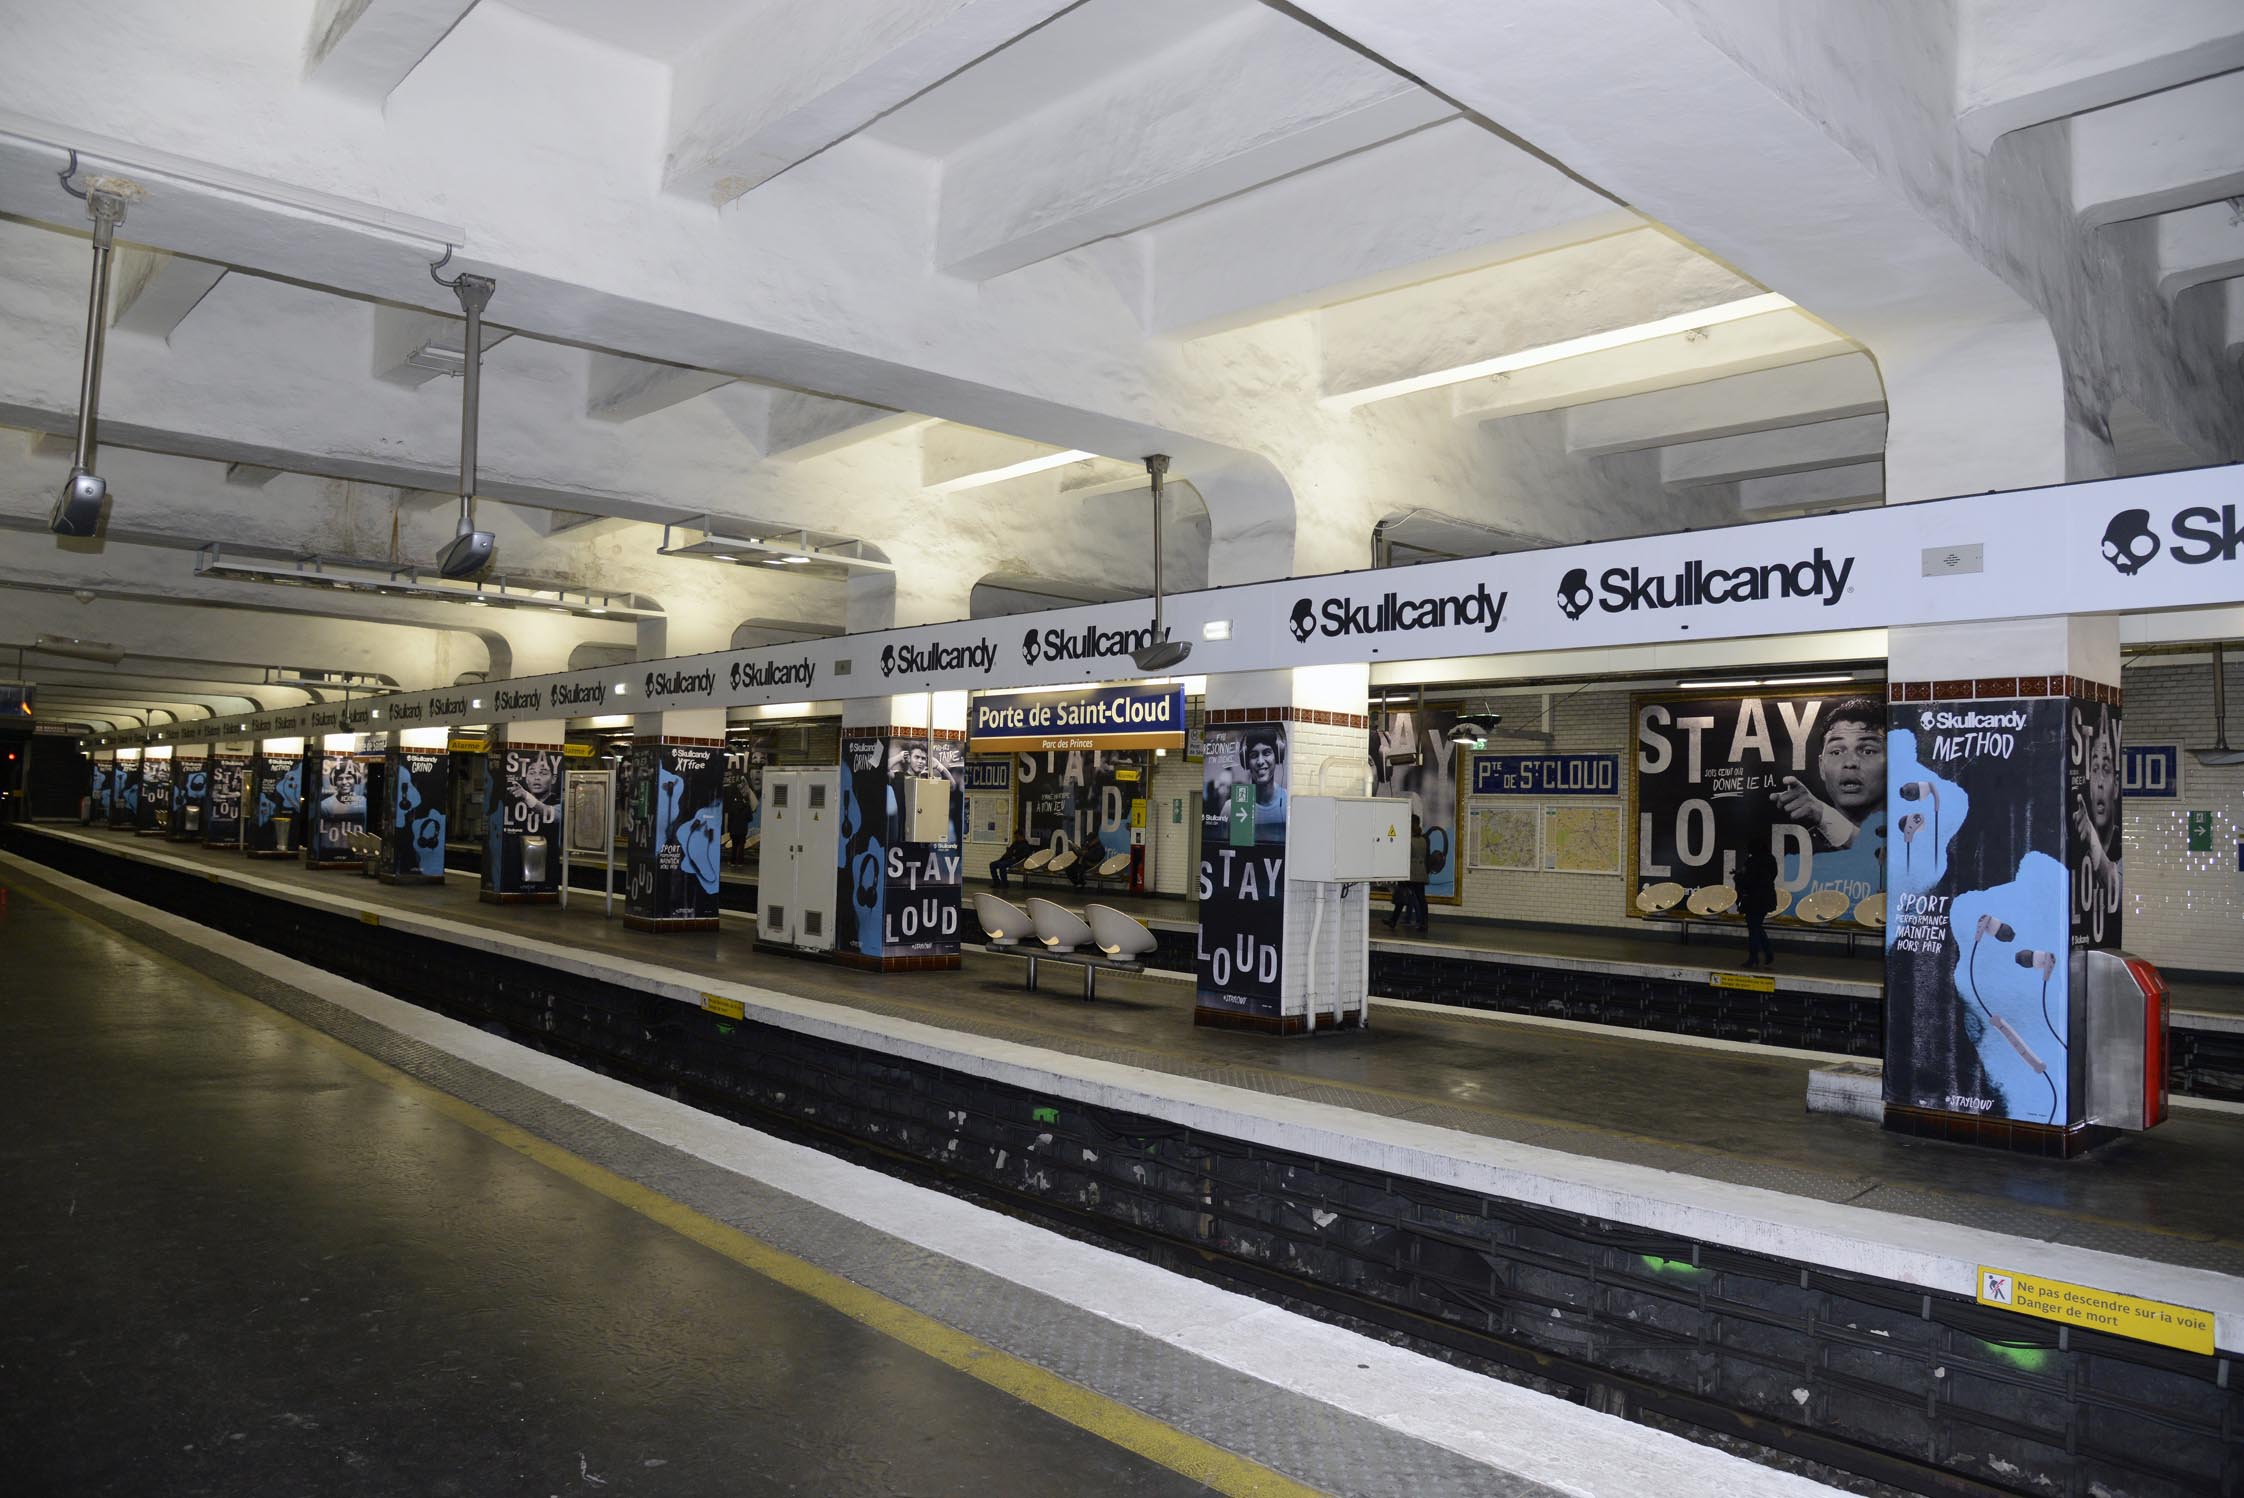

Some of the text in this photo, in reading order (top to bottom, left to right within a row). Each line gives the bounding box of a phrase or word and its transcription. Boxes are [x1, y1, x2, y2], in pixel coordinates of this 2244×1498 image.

[1598, 547, 1855, 613] Skullcandy
[1320, 583, 1508, 637] Skullcandy
[1043, 619, 1171, 661] Skullcand
[897, 637, 997, 674] Skullcandy
[655, 668, 715, 696] Skullcandy
[742, 657, 816, 688] Skullcandy
[435, 696, 468, 717] Skullcandy
[500, 689, 542, 711] Skullcandy
[557, 681, 606, 706] Skullcandy
[393, 702, 424, 720] Skullcandy
[978, 694, 1170, 729] Porte de Saint-Cloud
[1936, 710, 2027, 731] Skullcandy
[452, 741, 481, 750] Alarme
[677, 750, 710, 760] Skullcandy
[1042, 738, 1093, 748] Parc des Princes
[1639, 698, 1822, 784] STAY
[1932, 732, 2014, 761] METHOD
[2072, 703, 2122, 780] STAY
[143, 761, 170, 774] STA
[214, 767, 243, 784] STA
[411, 762, 433, 774] GRIND
[506, 750, 562, 778] STAY
[973, 765, 1007, 786] CLOUD
[1504, 774, 1517, 789] DE
[1543, 760, 1612, 789] CLOUD
[1713, 774, 1777, 791] DONNE LE LA.
[213, 802, 238, 819] LOU
[504, 801, 555, 833] LOUD
[628, 807, 654, 848] STAY
[887, 847, 960, 891] STAY
[1200, 850, 1283, 901] STAY
[1897, 892, 1949, 915] SPORT
[2072, 856, 2120, 943] LOUD
[886, 898, 958, 943] LOUD
[1895, 914, 1949, 925] PERFORMANCE
[1895, 925, 1946, 941] MAINTIEN
[1197, 923, 1277, 986] LOUD
[1897, 939, 1942, 954] HORS PAIR
[2017, 1281, 2035, 1294] Ne
[2039, 1287, 2060, 1299] pas
[2064, 1291, 2131, 1314] descendre
[2134, 1307, 2157, 1319] sur
[2176, 1316, 2206, 1331] voie
[2017, 1295, 2119, 1327] Danger de mort
